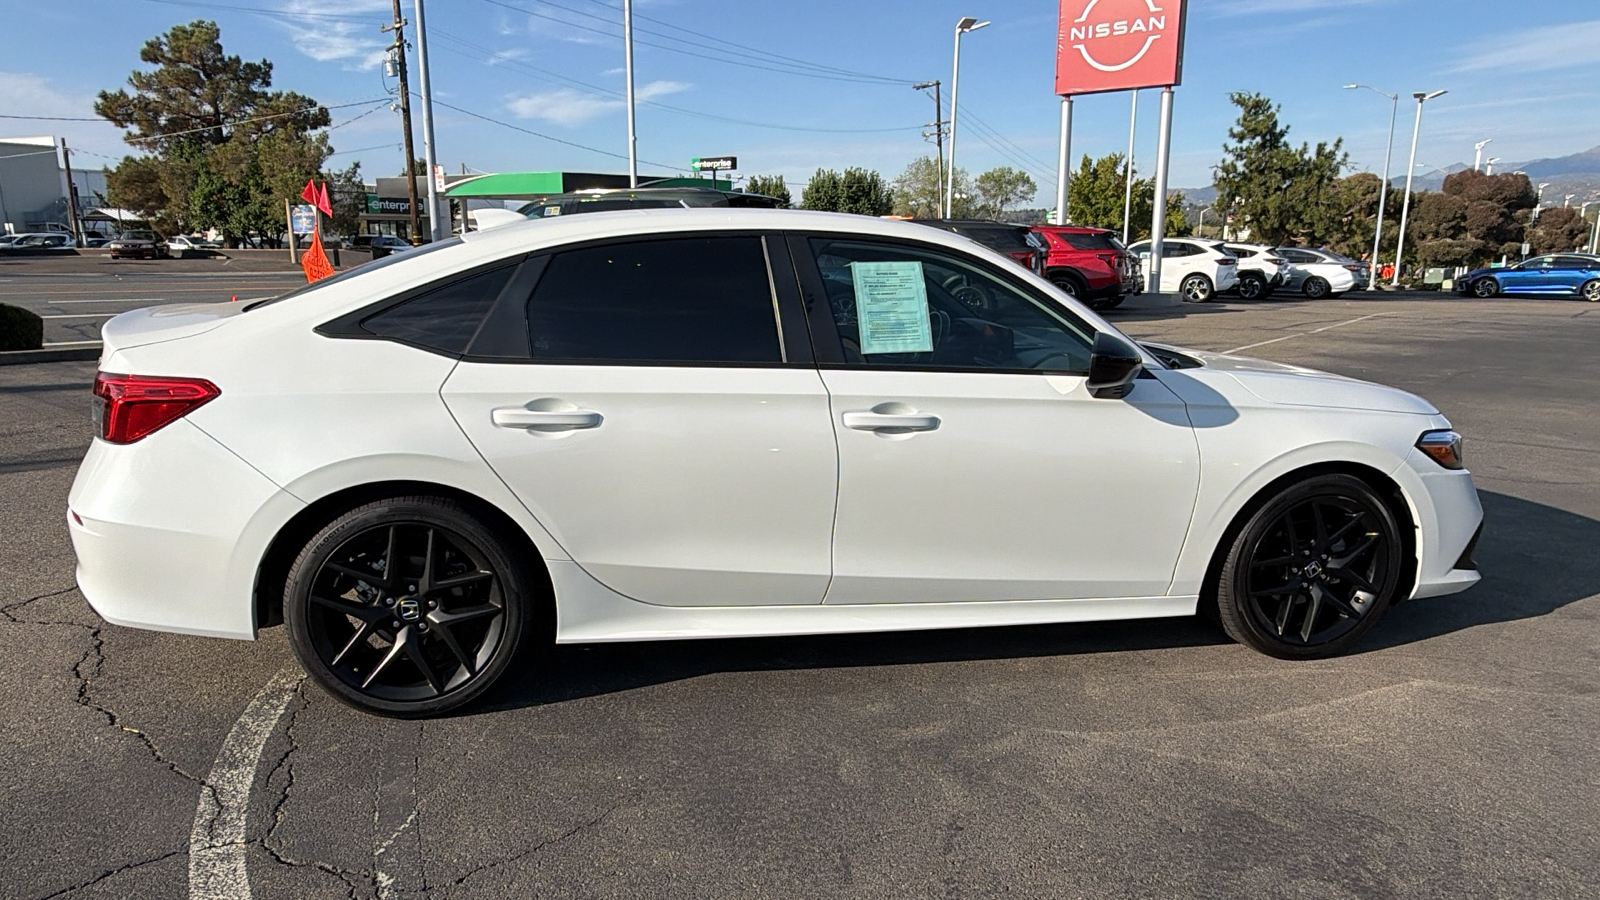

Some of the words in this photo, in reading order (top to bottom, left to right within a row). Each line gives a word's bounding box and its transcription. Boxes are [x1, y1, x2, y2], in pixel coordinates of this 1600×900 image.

[1070, 15, 1165, 41] NISSAN
[368, 200, 424, 212] enterpre
[311, 524, 345, 554] VELOCITY
